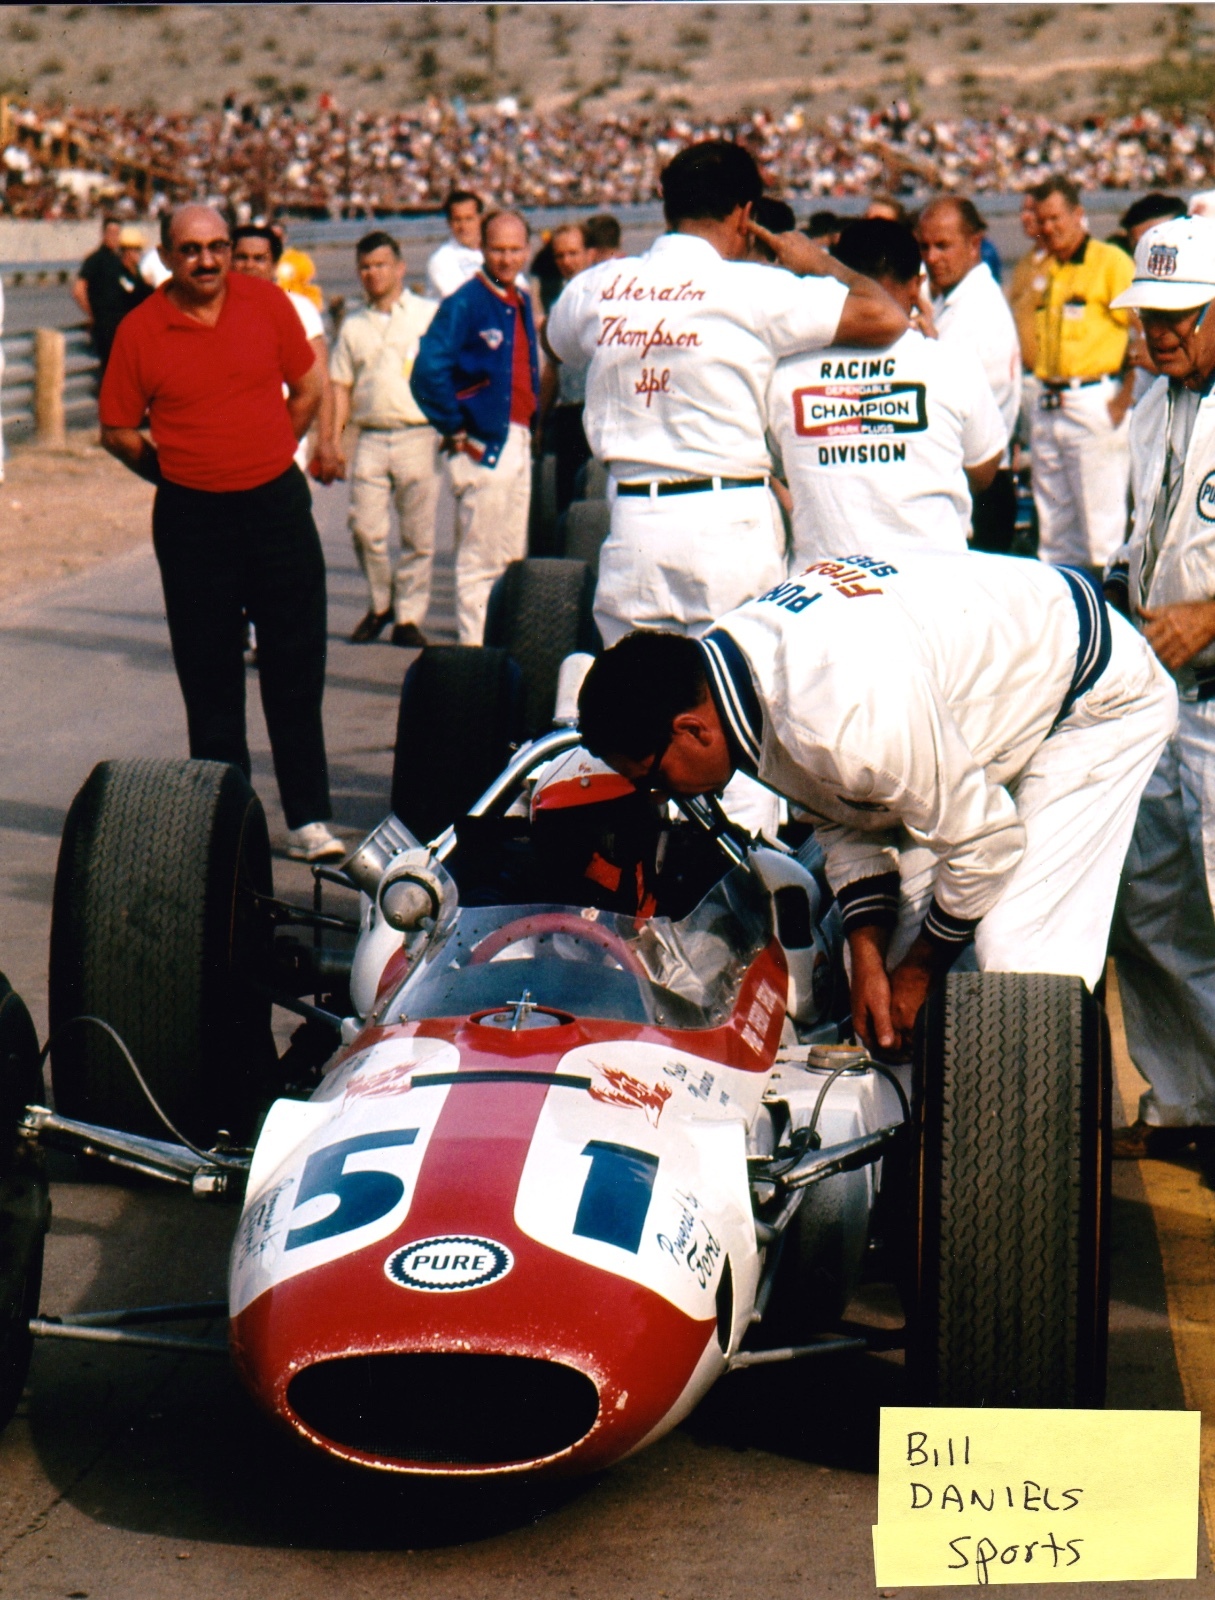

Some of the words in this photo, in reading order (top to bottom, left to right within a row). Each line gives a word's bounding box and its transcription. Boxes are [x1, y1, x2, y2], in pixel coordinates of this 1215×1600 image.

[600, 275, 706, 302] Sheraton
[597, 317, 702, 359] Thompson
[820, 359, 895, 379] RACING
[811, 401, 909, 419] CHAMPION
[827, 426, 860, 436] SPARK
[861, 424, 894, 435] PLUGS
[818, 443, 906, 465] DIVISION
[1201, 483, 1215, 504] PU
[656, 1196, 696, 1265] Powered
[411, 1255, 488, 1270] PURE
[687, 1220, 720, 1290] Ford
[907, 1431, 970, 1467] Bill
[910, 1481, 1084, 1512] DANIELS
